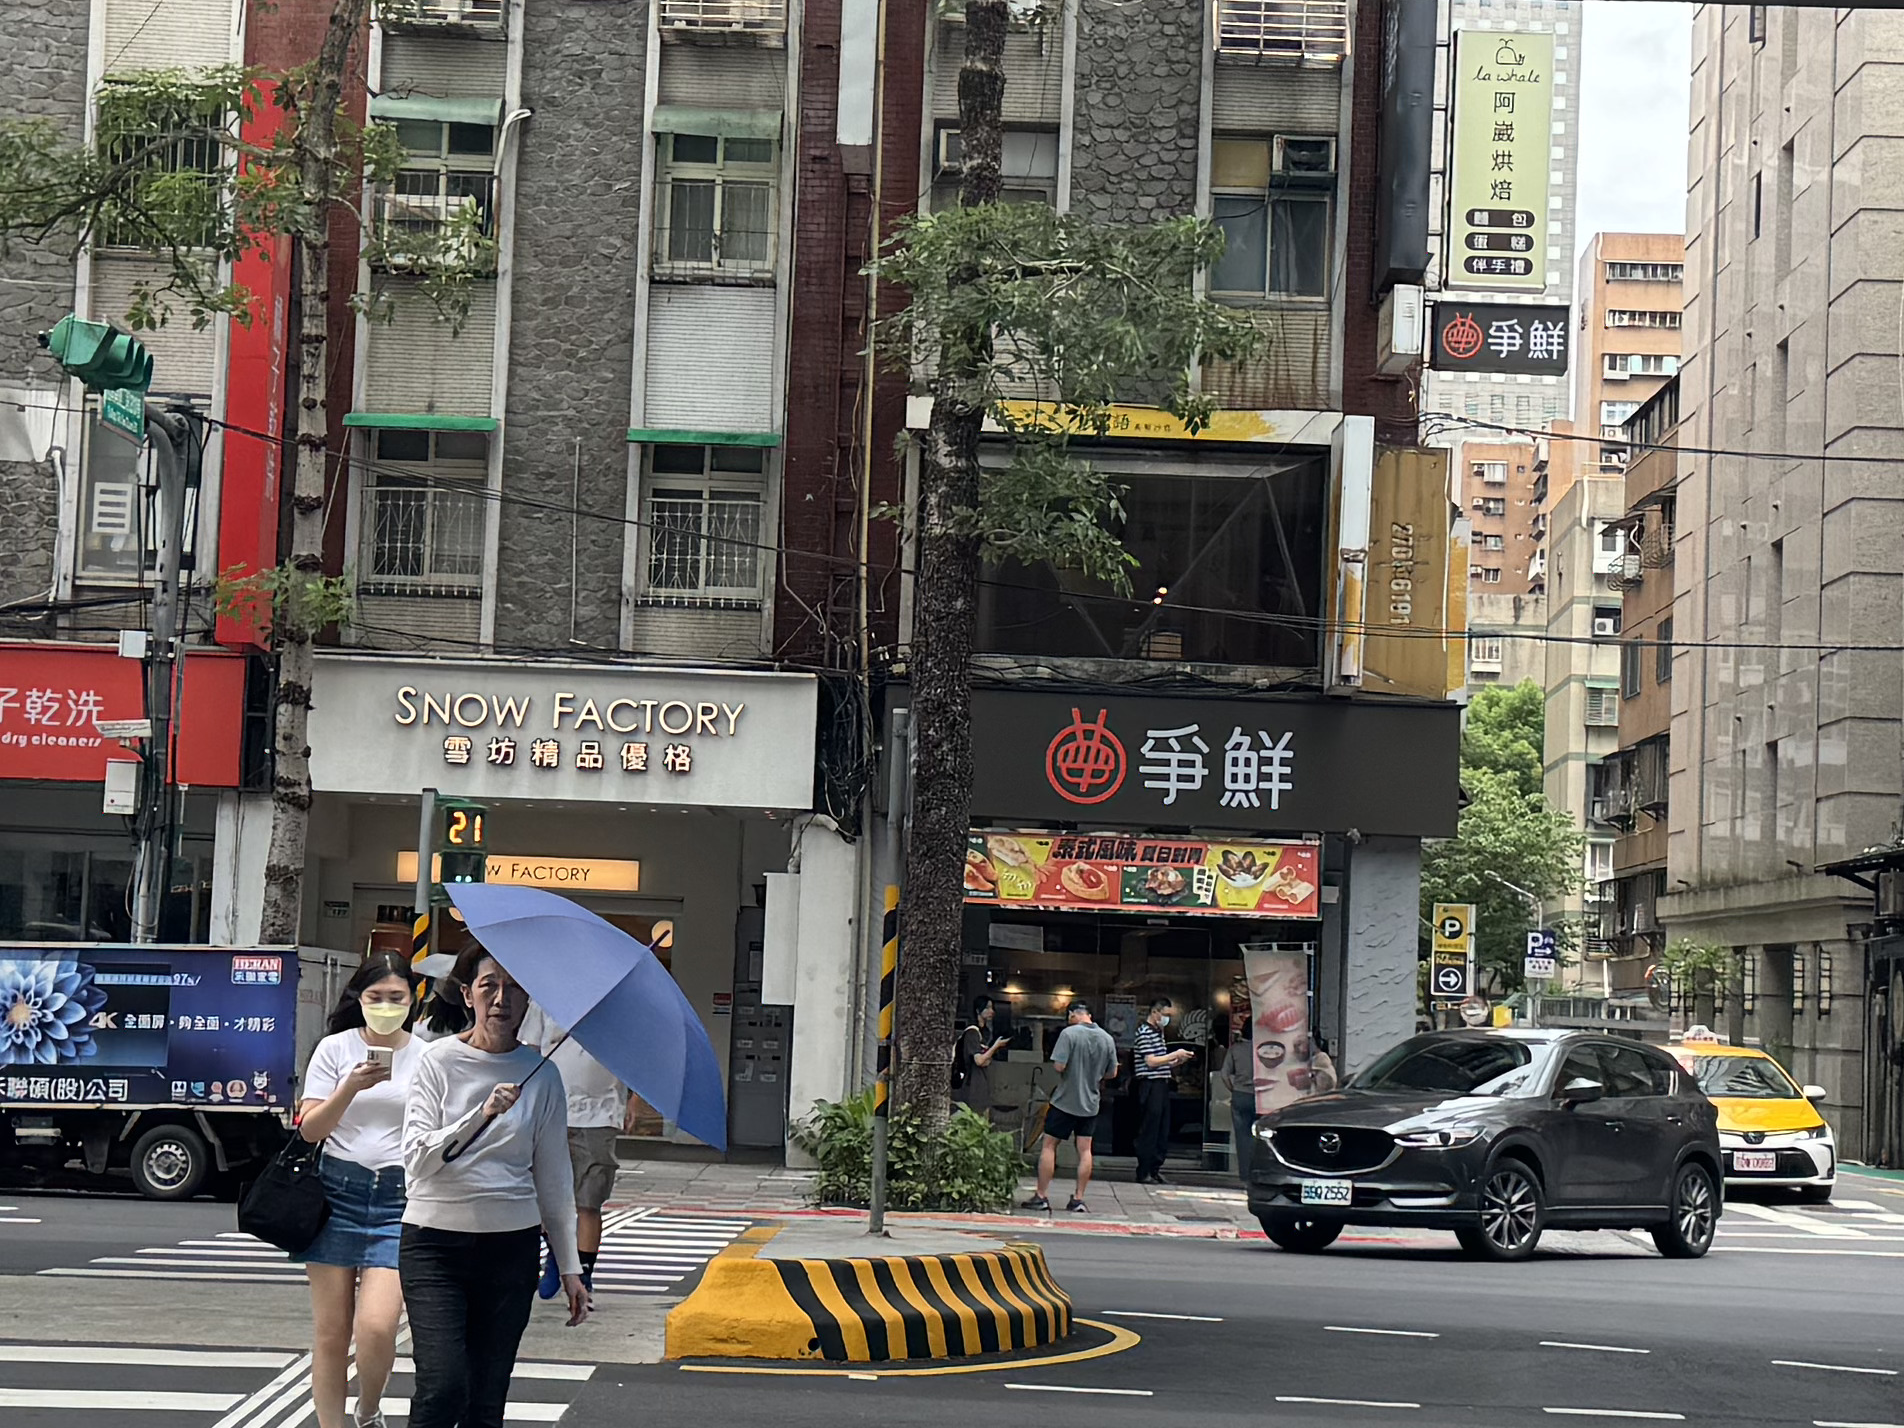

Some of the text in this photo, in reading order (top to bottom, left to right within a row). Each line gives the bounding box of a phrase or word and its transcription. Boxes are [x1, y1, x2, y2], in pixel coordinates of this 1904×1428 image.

[1496, 66, 1541, 84] whale
[1487, 318, 1566, 361] 爭鮮
[394, 685, 746, 736] SNOW FACTORY
[1, 731, 27, 748] dry
[31, 733, 103, 748] cleaners
[443, 735, 693, 773] 雪坊精品優格
[1138, 723, 1294, 811] 爭鮮
[448, 810, 483, 845] 21
[511, 862, 591, 883] FACTORY
[1444, 919, 1461, 938] P
[1527, 931, 1544, 955] P
